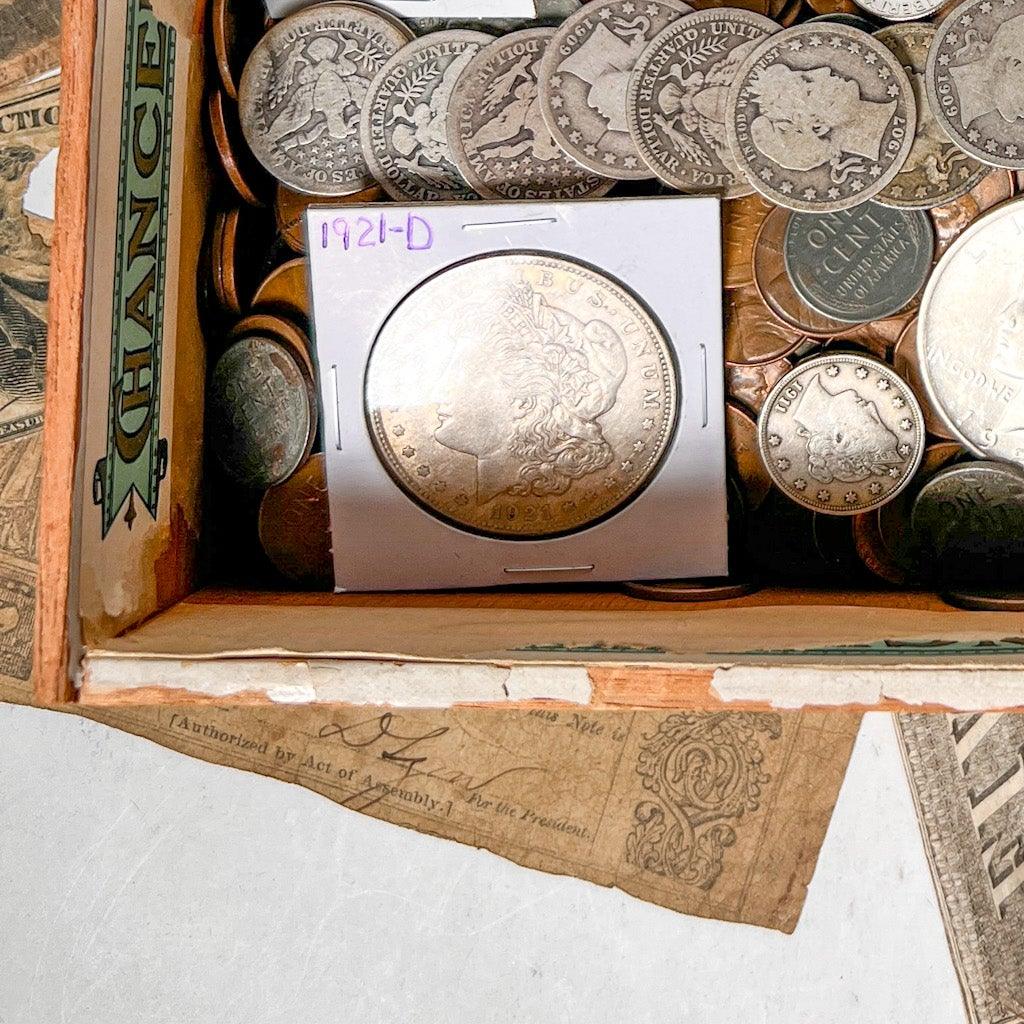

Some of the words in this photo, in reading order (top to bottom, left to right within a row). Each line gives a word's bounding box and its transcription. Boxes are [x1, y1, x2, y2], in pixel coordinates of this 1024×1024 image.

[559, 17, 594, 56] 1909
[937, 73, 960, 119] 1909
[640, 105, 682, 171] DOLLAR
[735, 105, 750, 144] GOD
[884, 113, 907, 162] 1907
[739, 144, 757, 162] IN
[319, 211, 435, 251] 1921-D
[806, 207, 859, 249] ONE
[822, 207, 885, 274] CENT
[836, 256, 873, 298] UNITED
[854, 283, 870, 301] OF
[618, 318, 663, 413] UNUM
[775, 379, 804, 414] 1911
[988, 376, 1015, 404] WE
[274, 745, 297, 765] by
[300, 752, 333, 775] Act
[337, 765, 360, 783] of
[464, 791, 493, 810] For
[494, 799, 517, 818] the
[519, 808, 592, 840] President.
